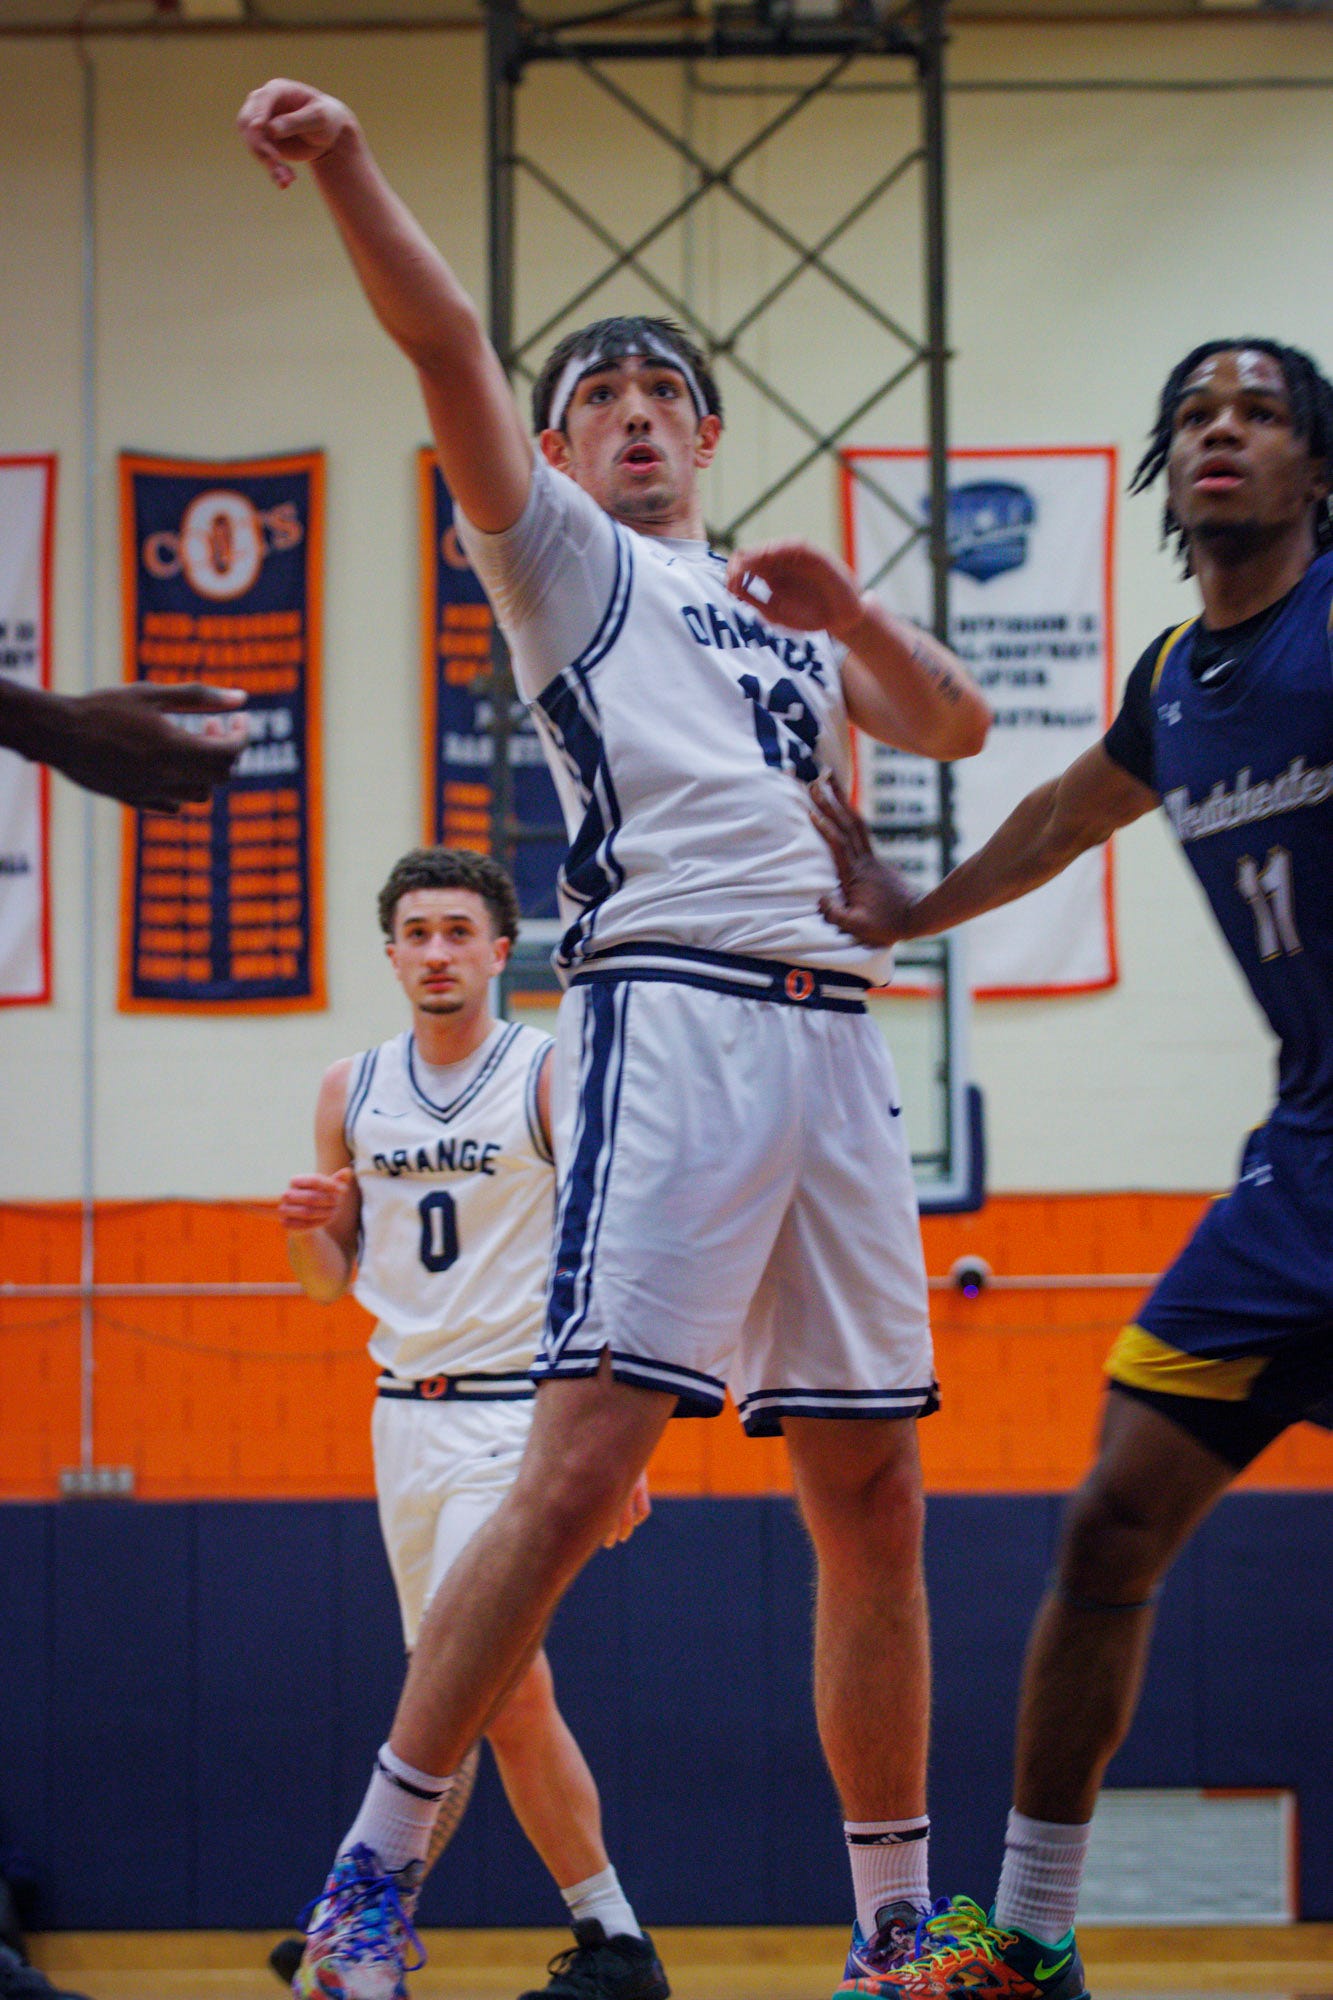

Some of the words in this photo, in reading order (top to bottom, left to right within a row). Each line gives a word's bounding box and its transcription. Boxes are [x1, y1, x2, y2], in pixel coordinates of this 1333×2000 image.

[1235, 846, 1303, 962] 11
[373, 1137, 502, 1176] ORANGE
[418, 1190, 460, 1273] 0
